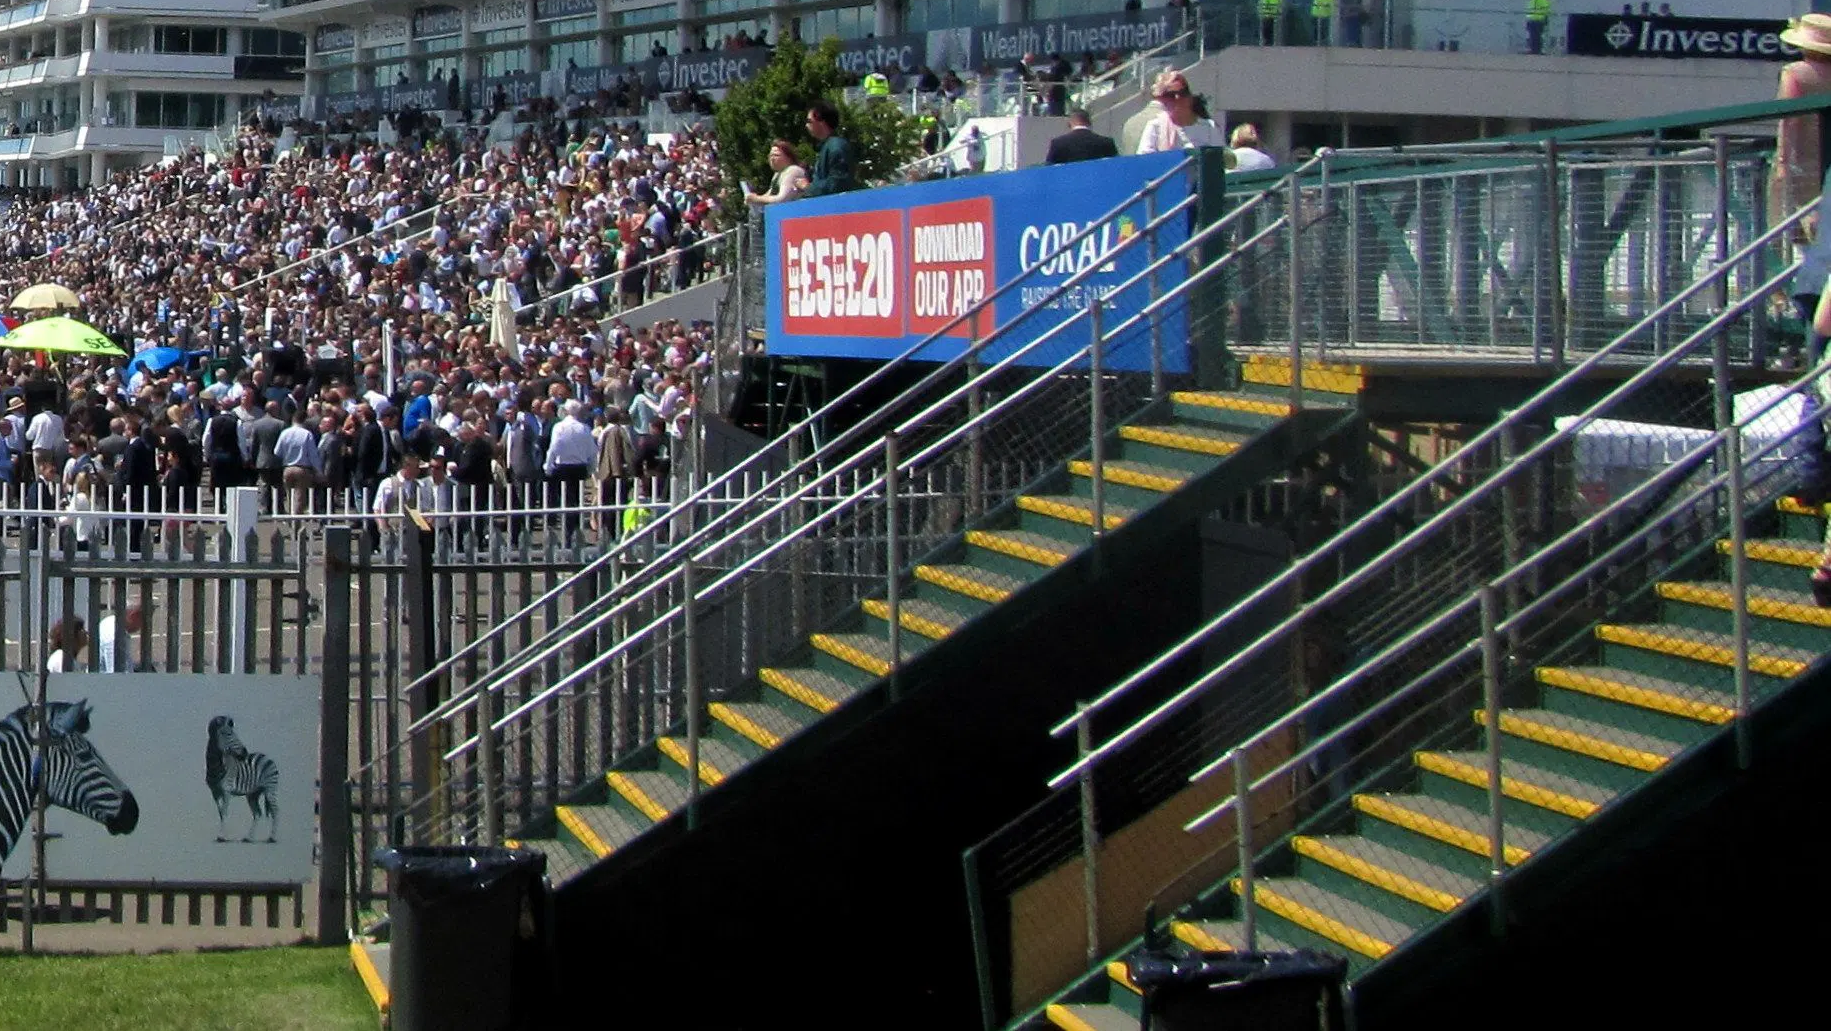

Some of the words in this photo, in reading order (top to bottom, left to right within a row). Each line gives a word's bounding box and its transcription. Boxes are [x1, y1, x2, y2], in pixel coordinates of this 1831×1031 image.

[981, 26, 1041, 60] Wealth
[1044, 23, 1057, 55] &
[1062, 15, 1167, 52] Investment
[672, 55, 749, 89] Investec
[914, 221, 985, 264] DOWNLOAD
[1019, 220, 1116, 276] CORAL
[800, 237, 832, 318] £5
[846, 231, 894, 318] £20
[914, 270, 949, 317] OUR
[951, 268, 985, 317] APP
